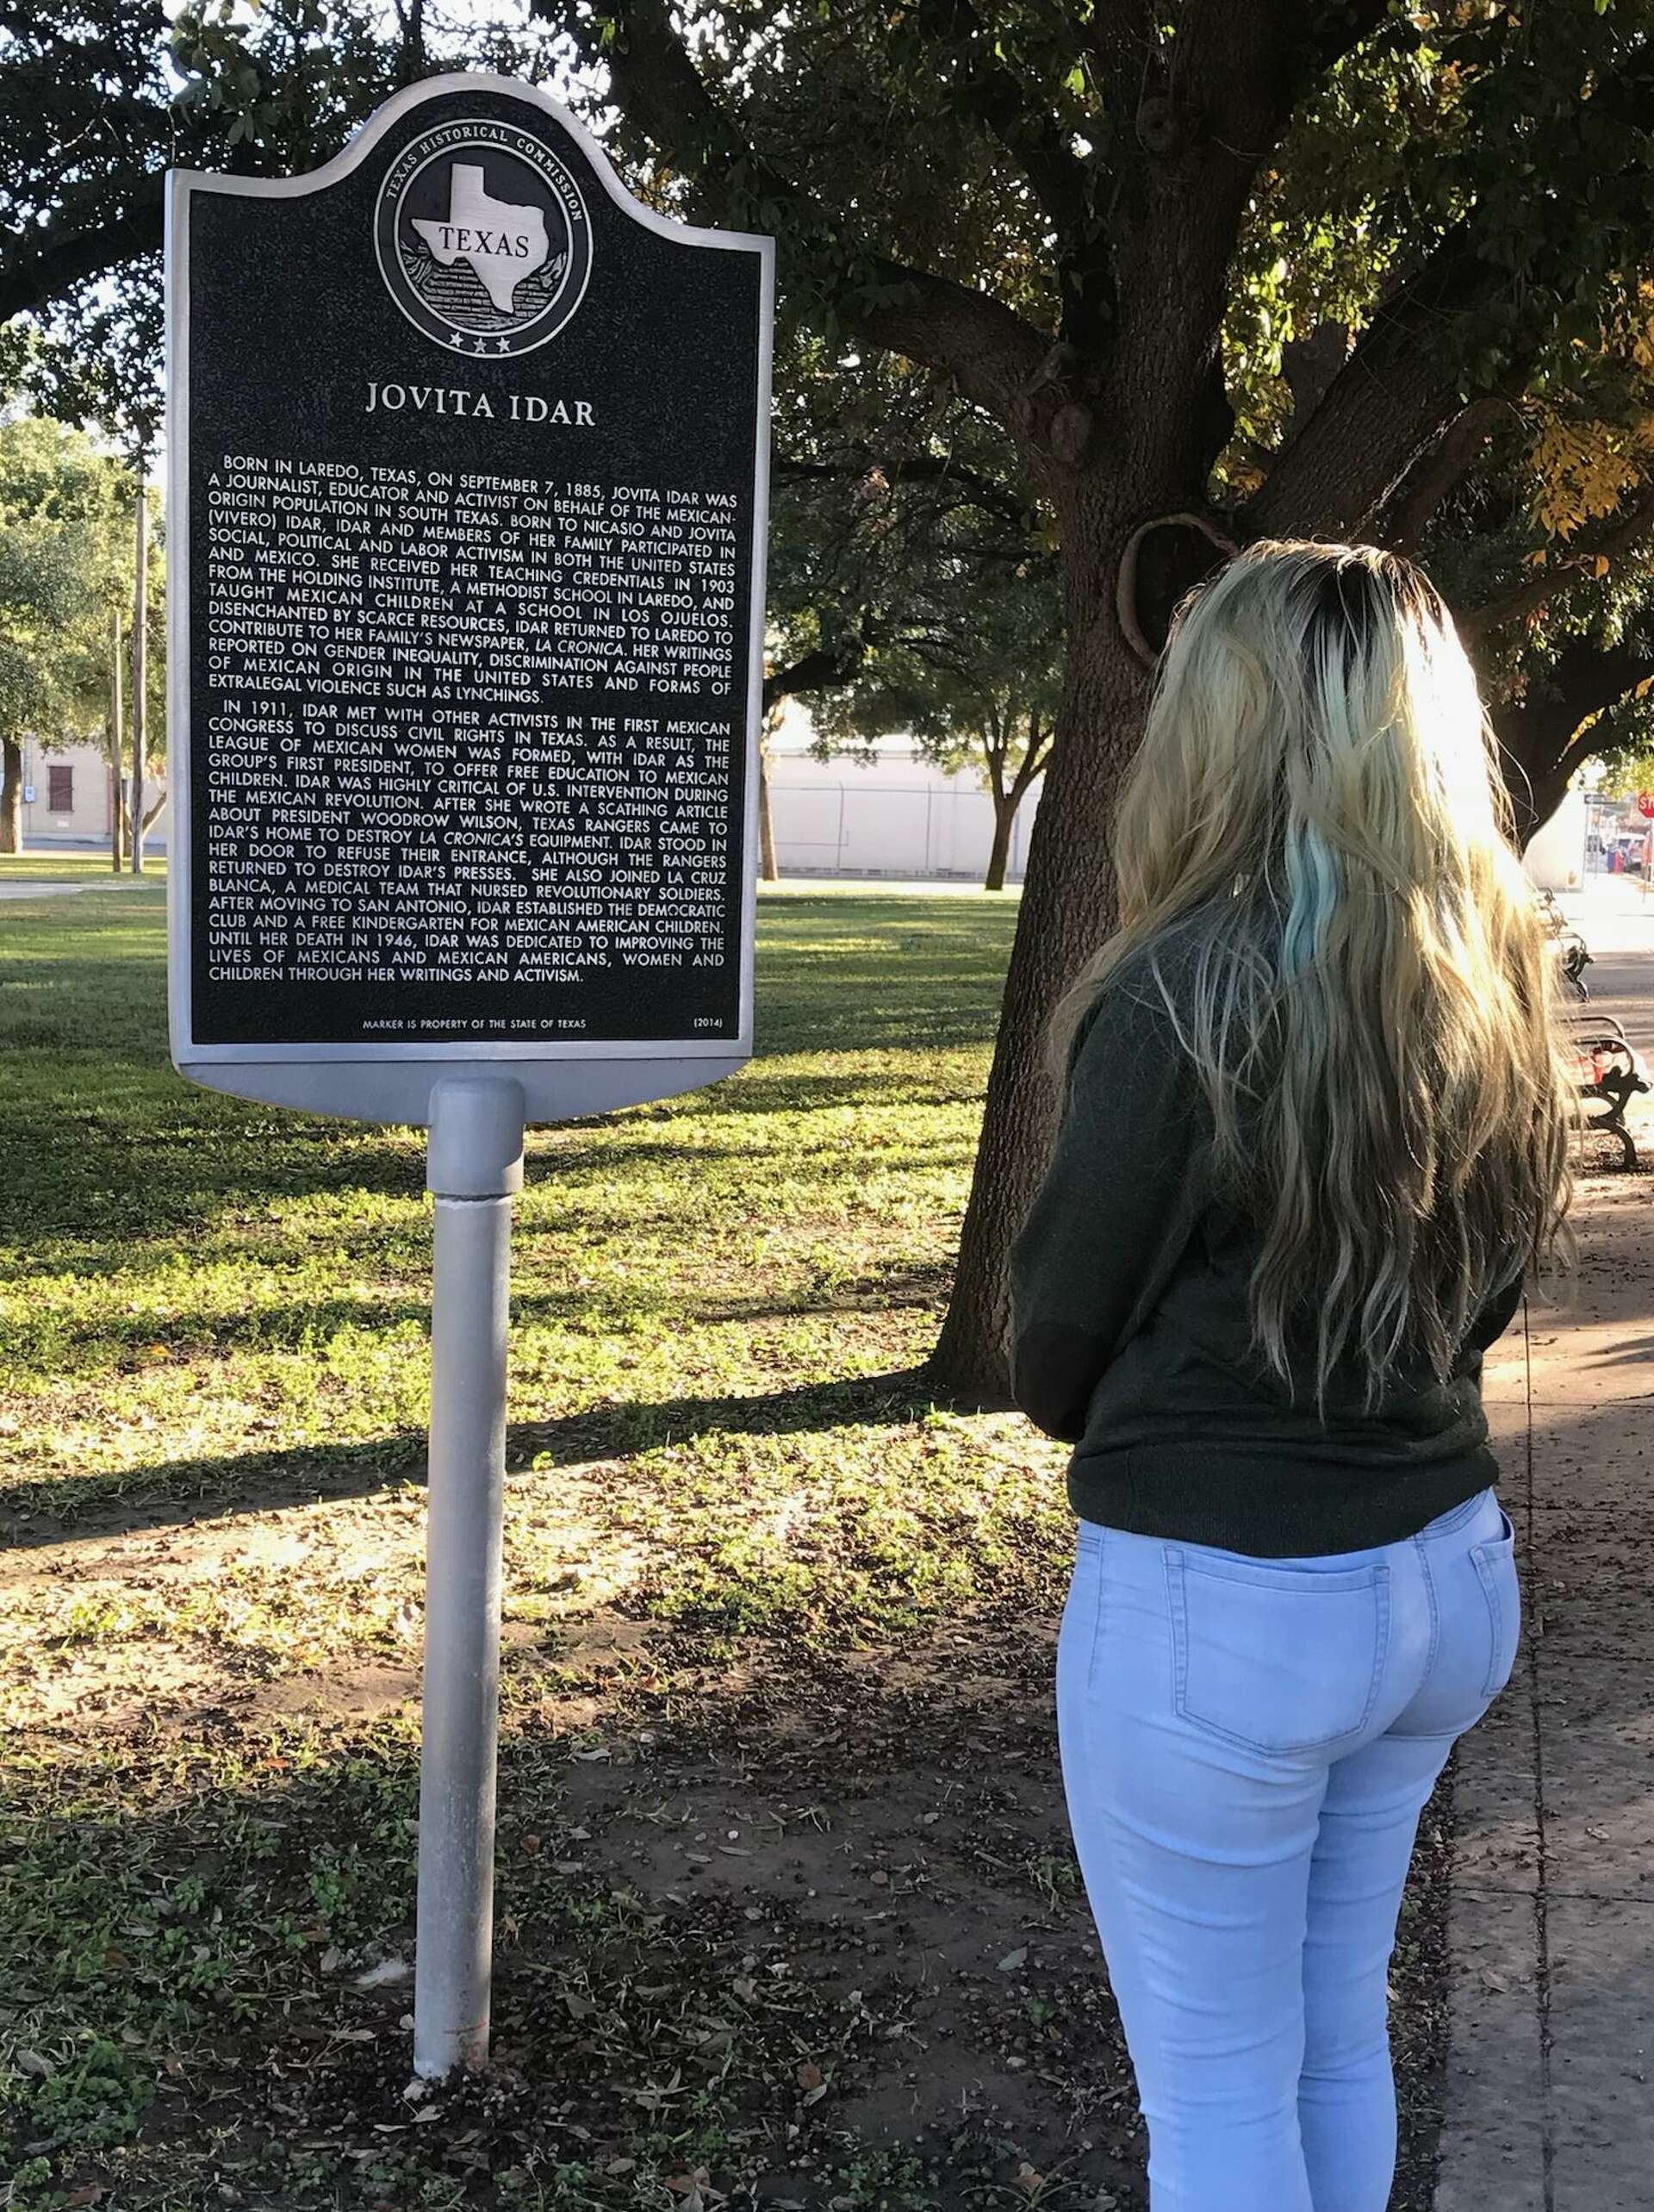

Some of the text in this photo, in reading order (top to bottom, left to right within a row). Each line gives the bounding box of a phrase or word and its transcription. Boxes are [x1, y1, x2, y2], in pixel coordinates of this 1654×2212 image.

[386, 126, 582, 221] TEXAS HISTORICAL COMMISSION
[438, 226, 530, 259] TEXAS
[366, 383, 596, 427] JOVITA IDAR
[207, 471, 736, 525] A JOURNALIST, EDUCATOR AND ACTIVIST ON BEHALF OF THE MEXICAN-
[223, 454, 737, 508] BORN IN LAREDO, TEXAS, ON SEPTEMBER 7, 1885, JOVITA IDAR WAS
[208, 508, 736, 559] (VIVERO) IDAR, IDAR AND MEMBERS OF HER FAMILY PARTICIPATED IN
[208, 545, 735, 594] AND MEXICO. SHE RECEIVED HER TEACHING CREDENTIALS IN 1903
[208, 582, 733, 627] TAUGHT MEXICAN CHILDREN AT A SCHOOL IN LOS OJUELOS.
[208, 618, 303, 641] CONTRIBUTE
[308, 623, 330, 642] TO
[334, 625, 364, 644] HER
[438, 630, 529, 654] NEWSPAPER,
[534, 634, 552, 652] LA
[557, 636, 628, 656] CRONICA.
[632, 639, 659, 657] HER
[662, 641, 733, 661] WRITINGS
[208, 655, 731, 695] OF MEXICAN ORIGIN IN THE UNITED STATES AND FORMS OF
[223, 699, 731, 735] IN 1911, IDAR MET WITH OTHER ACTIVISTS IN THE FIRST MEXICAN
[208, 734, 730, 769] LEAGUE OF MEXICAN WOMEN WAS FORMED, WITH IDAR AS THE
[208, 770, 729, 801] CHILDREN. IDAR WAS HIGHLY CRITICAL OF U.S. INTERVENTION DURING
[1639, 795, 1654, 811] ST
[208, 842, 727, 868] HER DOOR TO REFUSE THEIR ENTRANCE, ALTHOUGH THE RANGERS
[208, 878, 725, 900] BLANCA, A MEDICAL TEAM THAT NURSED REVOLUTIONARY SOLDIERS.
[208, 913, 724, 933] CLUB AND A FREE KINDERGARTEN FOR MEXICAN AMERICAN CHILDREN.
[208, 949, 724, 968] LIVES OF MEXICANS AND MEXICAN AMERICANS, WOMEN AND
[363, 1019, 587, 1029] MARKER IS PROPERTY OF THE STATE OF TEXAS
[693, 1018, 724, 1028] (2014)
